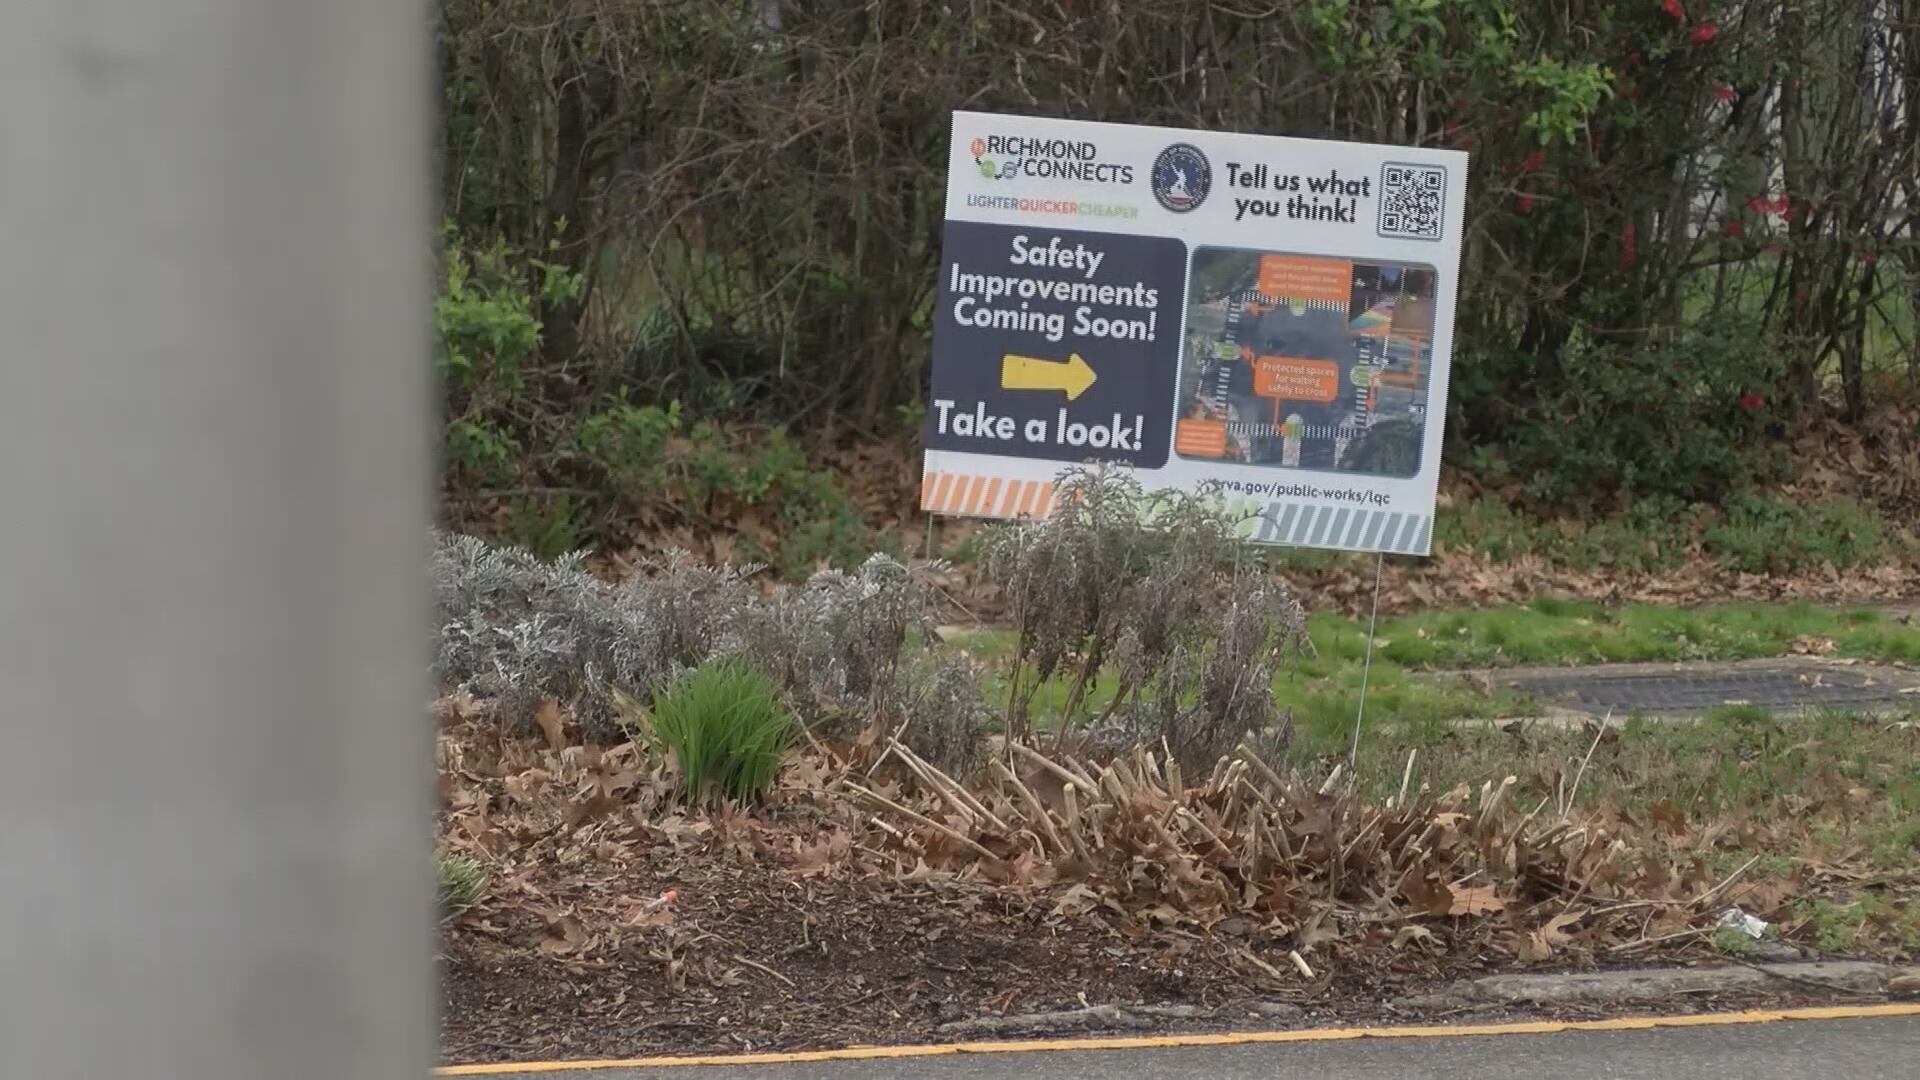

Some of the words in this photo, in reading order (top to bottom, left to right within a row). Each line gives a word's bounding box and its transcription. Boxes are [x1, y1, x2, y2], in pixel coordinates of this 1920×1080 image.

[987, 135, 1097, 161] RICHMOND
[1226, 162, 1268, 189] Tell
[1274, 175, 1300, 191] us
[1307, 169, 1370, 197] what
[1235, 198, 1280, 221] you
[1287, 194, 1356, 223] think!
[1009, 235, 1104, 278] Safety
[950, 262, 1158, 308] Improvements
[953, 296, 1065, 342] Coming
[1073, 305, 1157, 341] Soon!
[934, 399, 1016, 440] Take
[1024, 418, 1047, 443] a
[1056, 408, 1144, 451] look!
